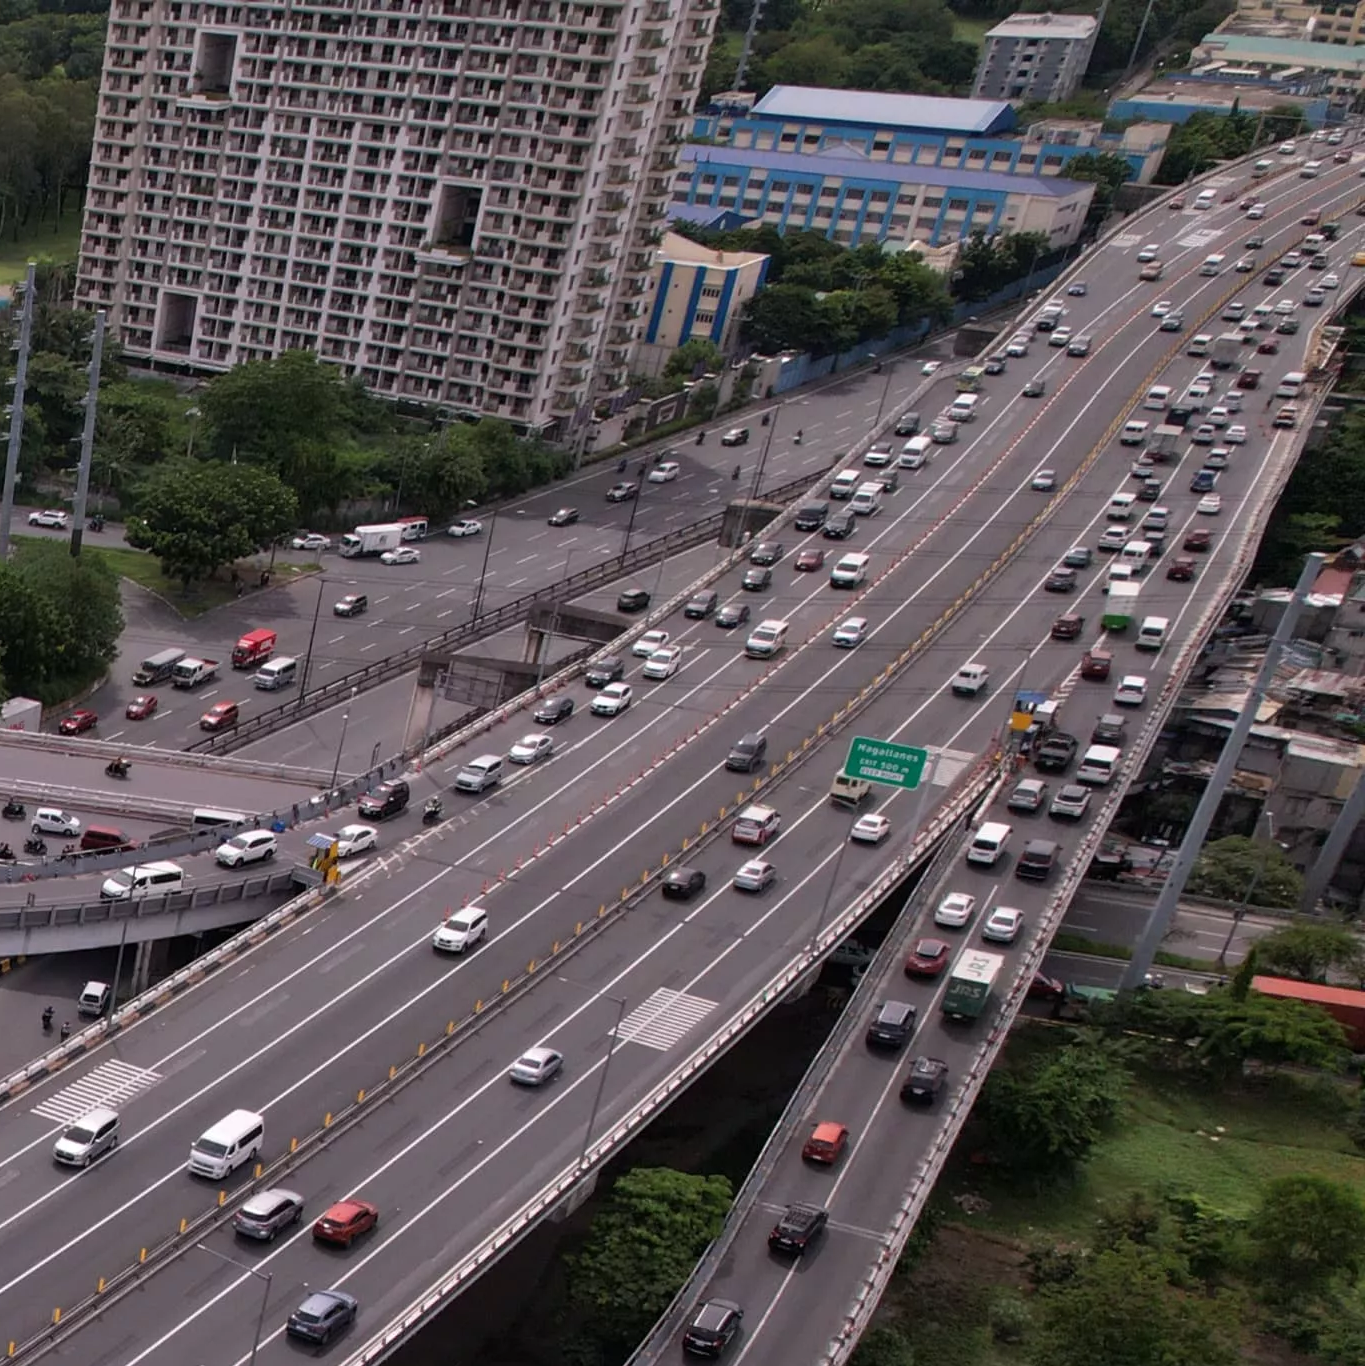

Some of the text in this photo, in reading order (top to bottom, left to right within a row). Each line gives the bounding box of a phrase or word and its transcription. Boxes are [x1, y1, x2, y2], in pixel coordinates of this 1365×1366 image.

[857, 743, 919, 763] Magallanes
[859, 757, 878, 766] EXIT
[880, 761, 899, 771] 500
[967, 956, 990, 977] JRS
[950, 984, 982, 998] JRS
